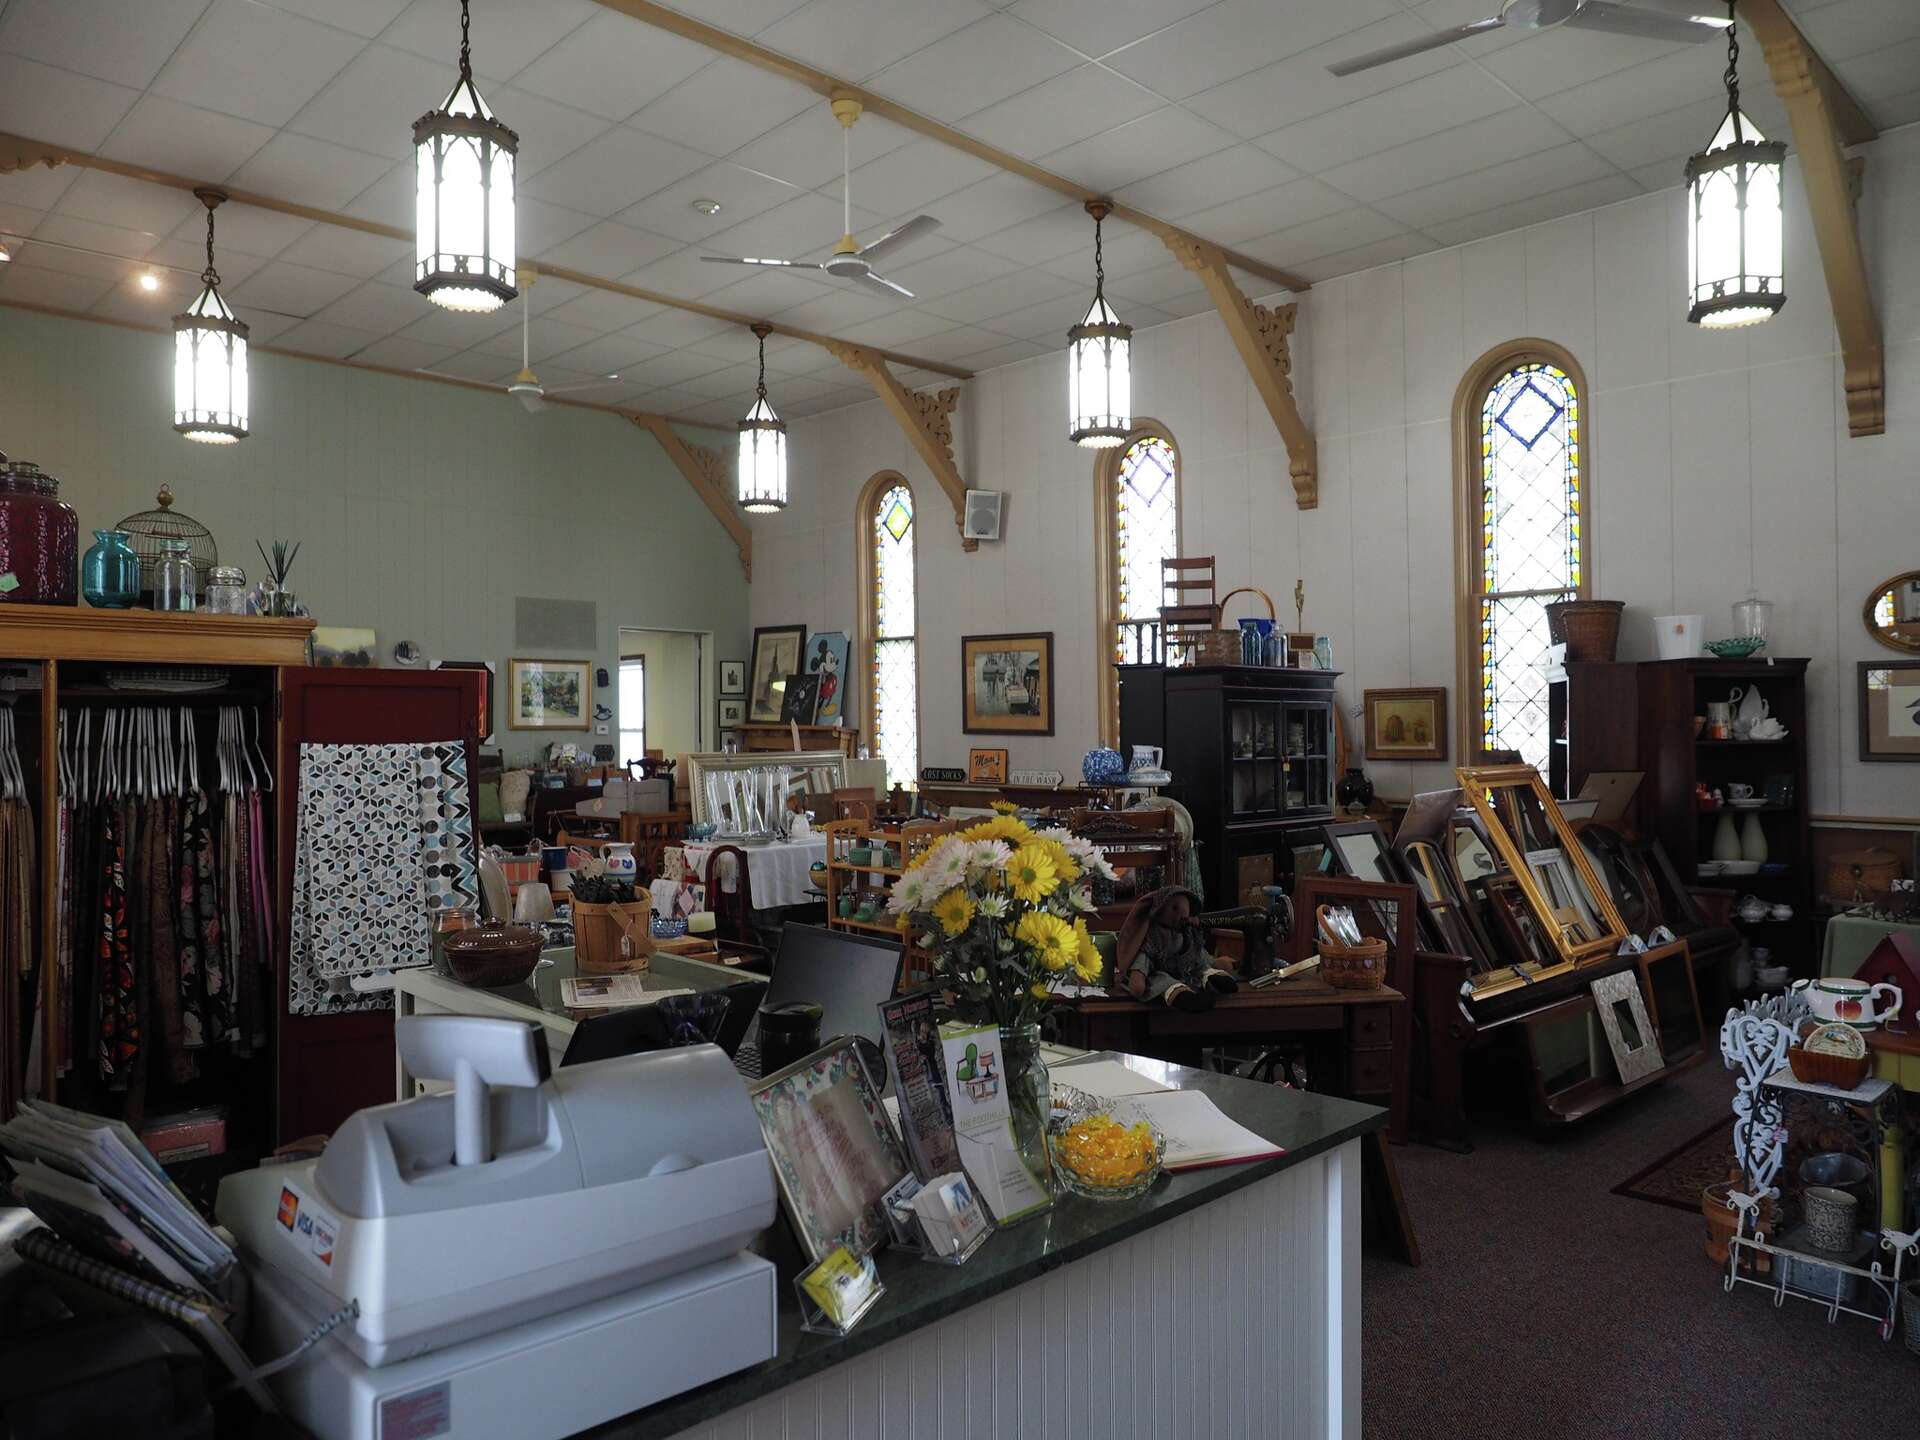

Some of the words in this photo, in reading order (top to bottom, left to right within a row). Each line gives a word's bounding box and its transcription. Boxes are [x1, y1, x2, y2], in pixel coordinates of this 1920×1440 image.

[924, 769, 941, 780] LOST
[941, 770, 962, 780] SOCKS
[1013, 775, 1021, 784] IN
[1022, 775, 1035, 784] THE
[1036, 775, 1057, 785] WASH
[297, 1210, 313, 1236] VISA
